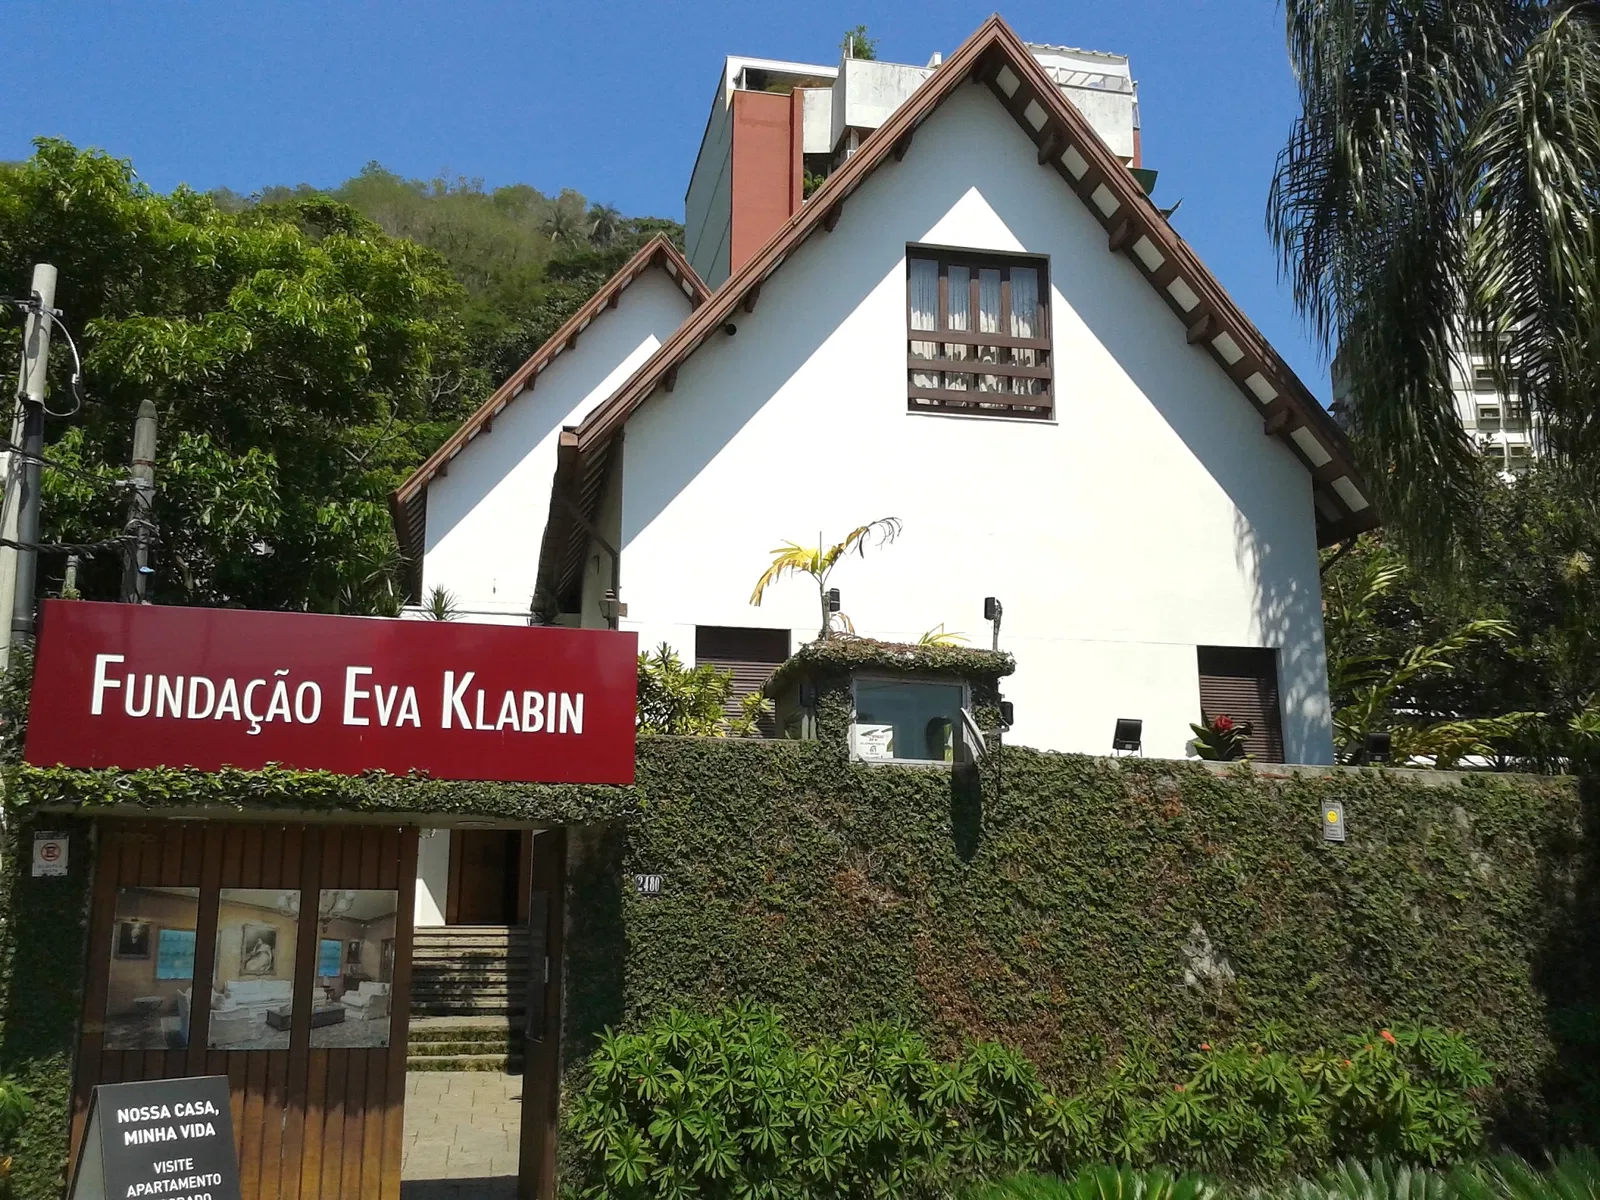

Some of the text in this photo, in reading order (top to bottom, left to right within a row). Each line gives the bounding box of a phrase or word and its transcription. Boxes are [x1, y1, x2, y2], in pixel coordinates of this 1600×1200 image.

[91, 653, 585, 735] FUNDAÇÃO EVA KLABIN
[636, 875, 660, 892] 2480
[116, 1100, 220, 1124] NOSSA CASA,
[123, 1121, 216, 1147] MINHA VIDA
[152, 1157, 195, 1174] VISITE
[126, 1172, 222, 1198] APARTAMENTO
